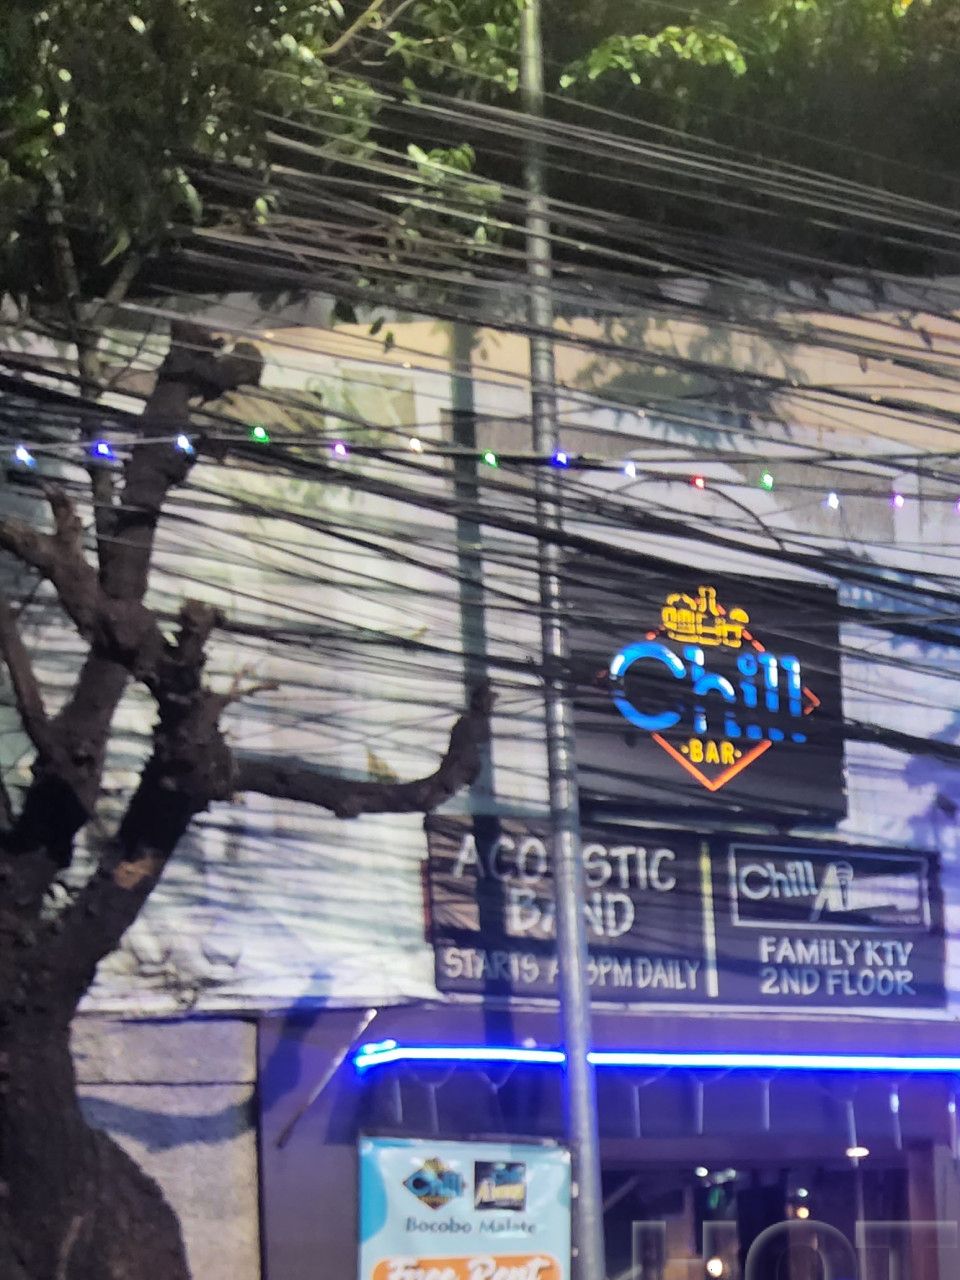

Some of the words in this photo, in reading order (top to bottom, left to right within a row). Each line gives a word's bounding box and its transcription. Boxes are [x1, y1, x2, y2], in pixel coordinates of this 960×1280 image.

[610, 640, 807, 744] Chill
[688, 737, 735, 764] BAR
[453, 833, 677, 892] ACOSTIC
[739, 860, 817, 900] Chill
[759, 935, 861, 966] FAMILY
[864, 939, 914, 967] KTV
[636, 956, 701, 991] DAILY
[760, 966, 820, 996] 2ND
[826, 969, 917, 997] FLOOR
